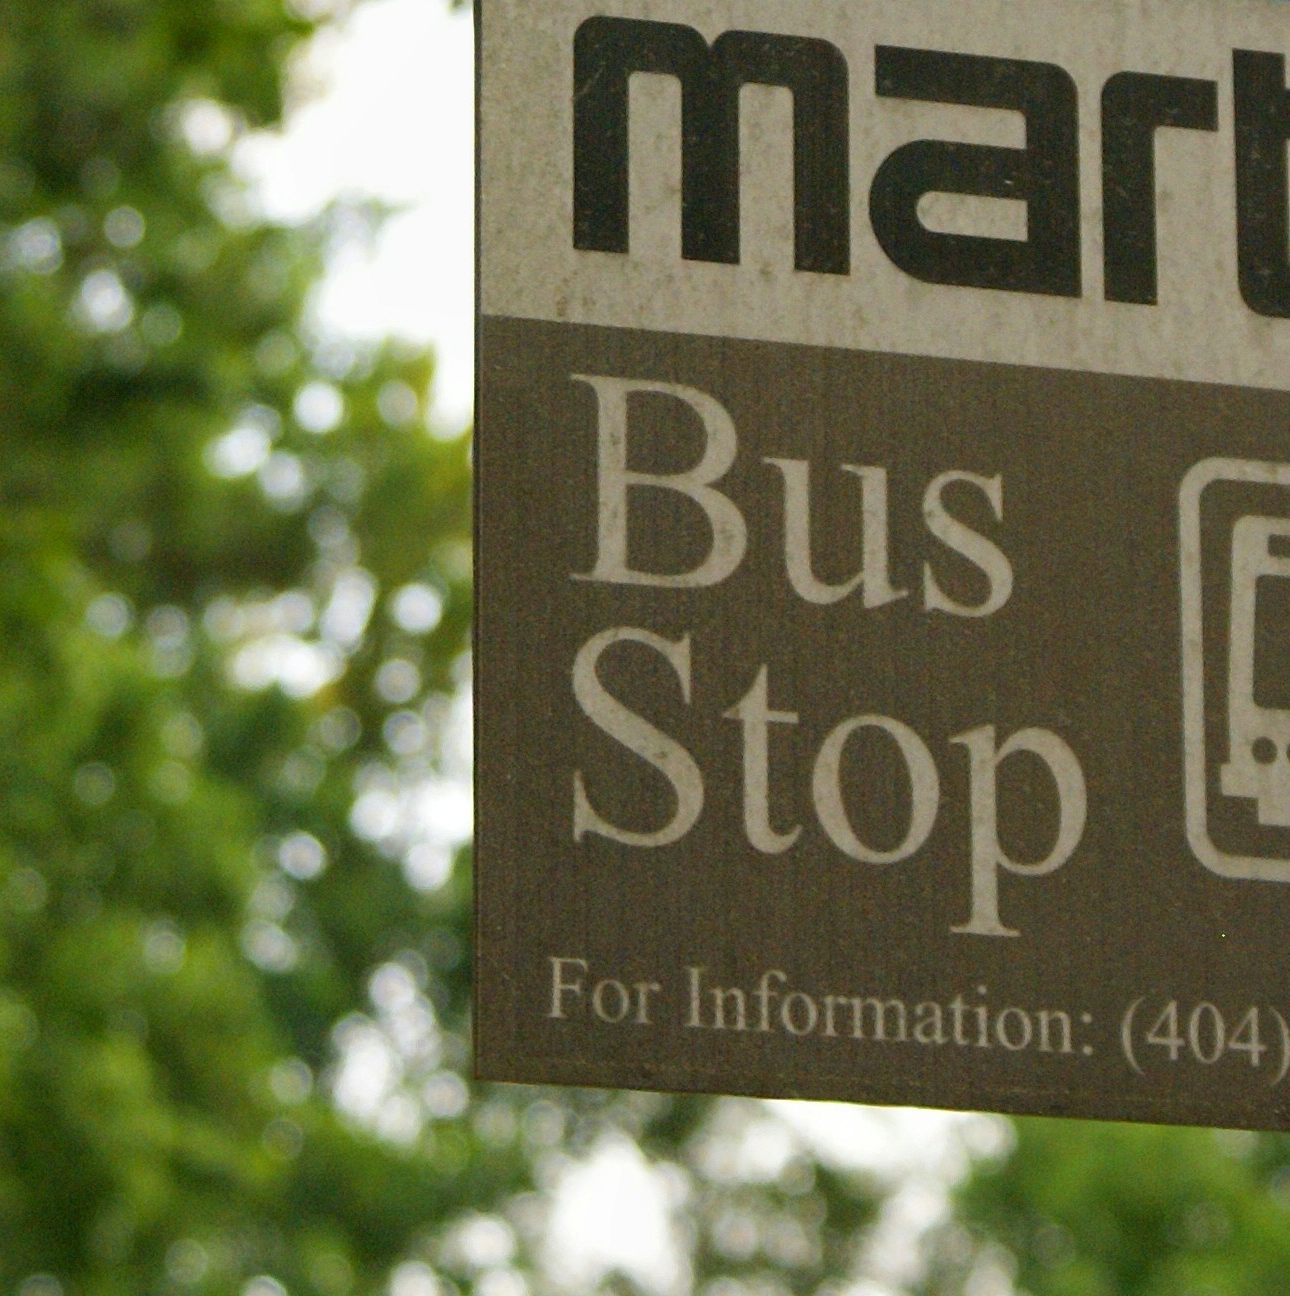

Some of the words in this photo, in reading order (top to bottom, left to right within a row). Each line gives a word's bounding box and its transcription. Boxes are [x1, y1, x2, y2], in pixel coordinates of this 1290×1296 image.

[569, 373, 1015, 618] Bus
[571, 626, 1088, 938] Stop
[546, 956, 661, 1025] For
[683, 964, 1095, 1055] Information:
